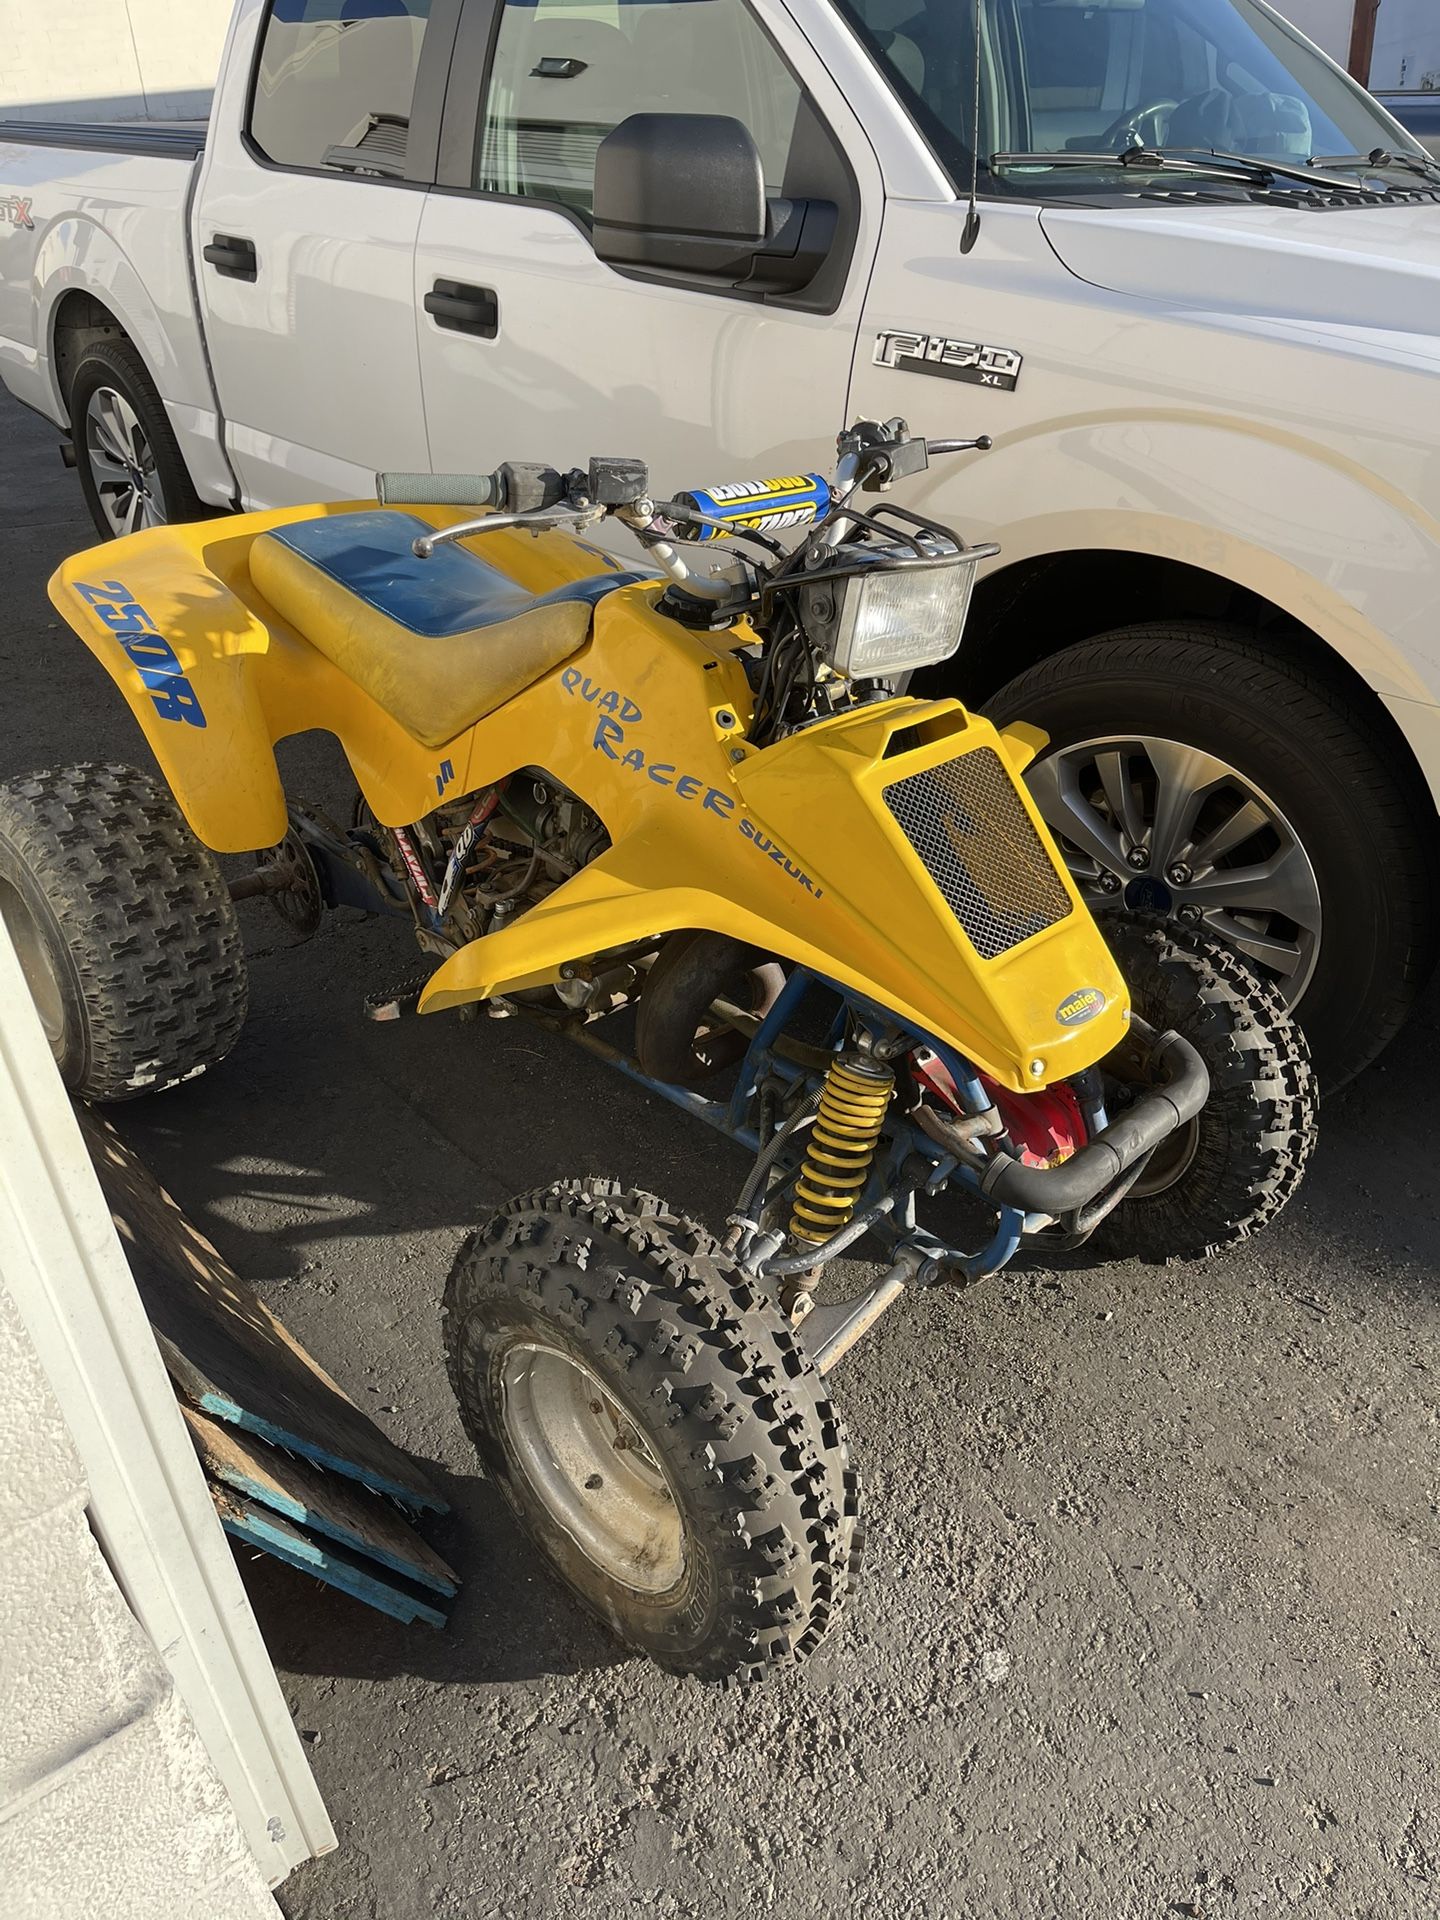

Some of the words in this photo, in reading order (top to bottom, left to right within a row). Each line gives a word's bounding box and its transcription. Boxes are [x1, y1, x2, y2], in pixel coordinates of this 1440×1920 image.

[872, 329, 1023, 377] F150
[980, 373, 1002, 386] XL
[561, 666, 643, 724] QUAD
[593, 713, 736, 820] RACER
[738, 817, 824, 900] SUZUKI
[1060, 991, 1098, 1019] maier
